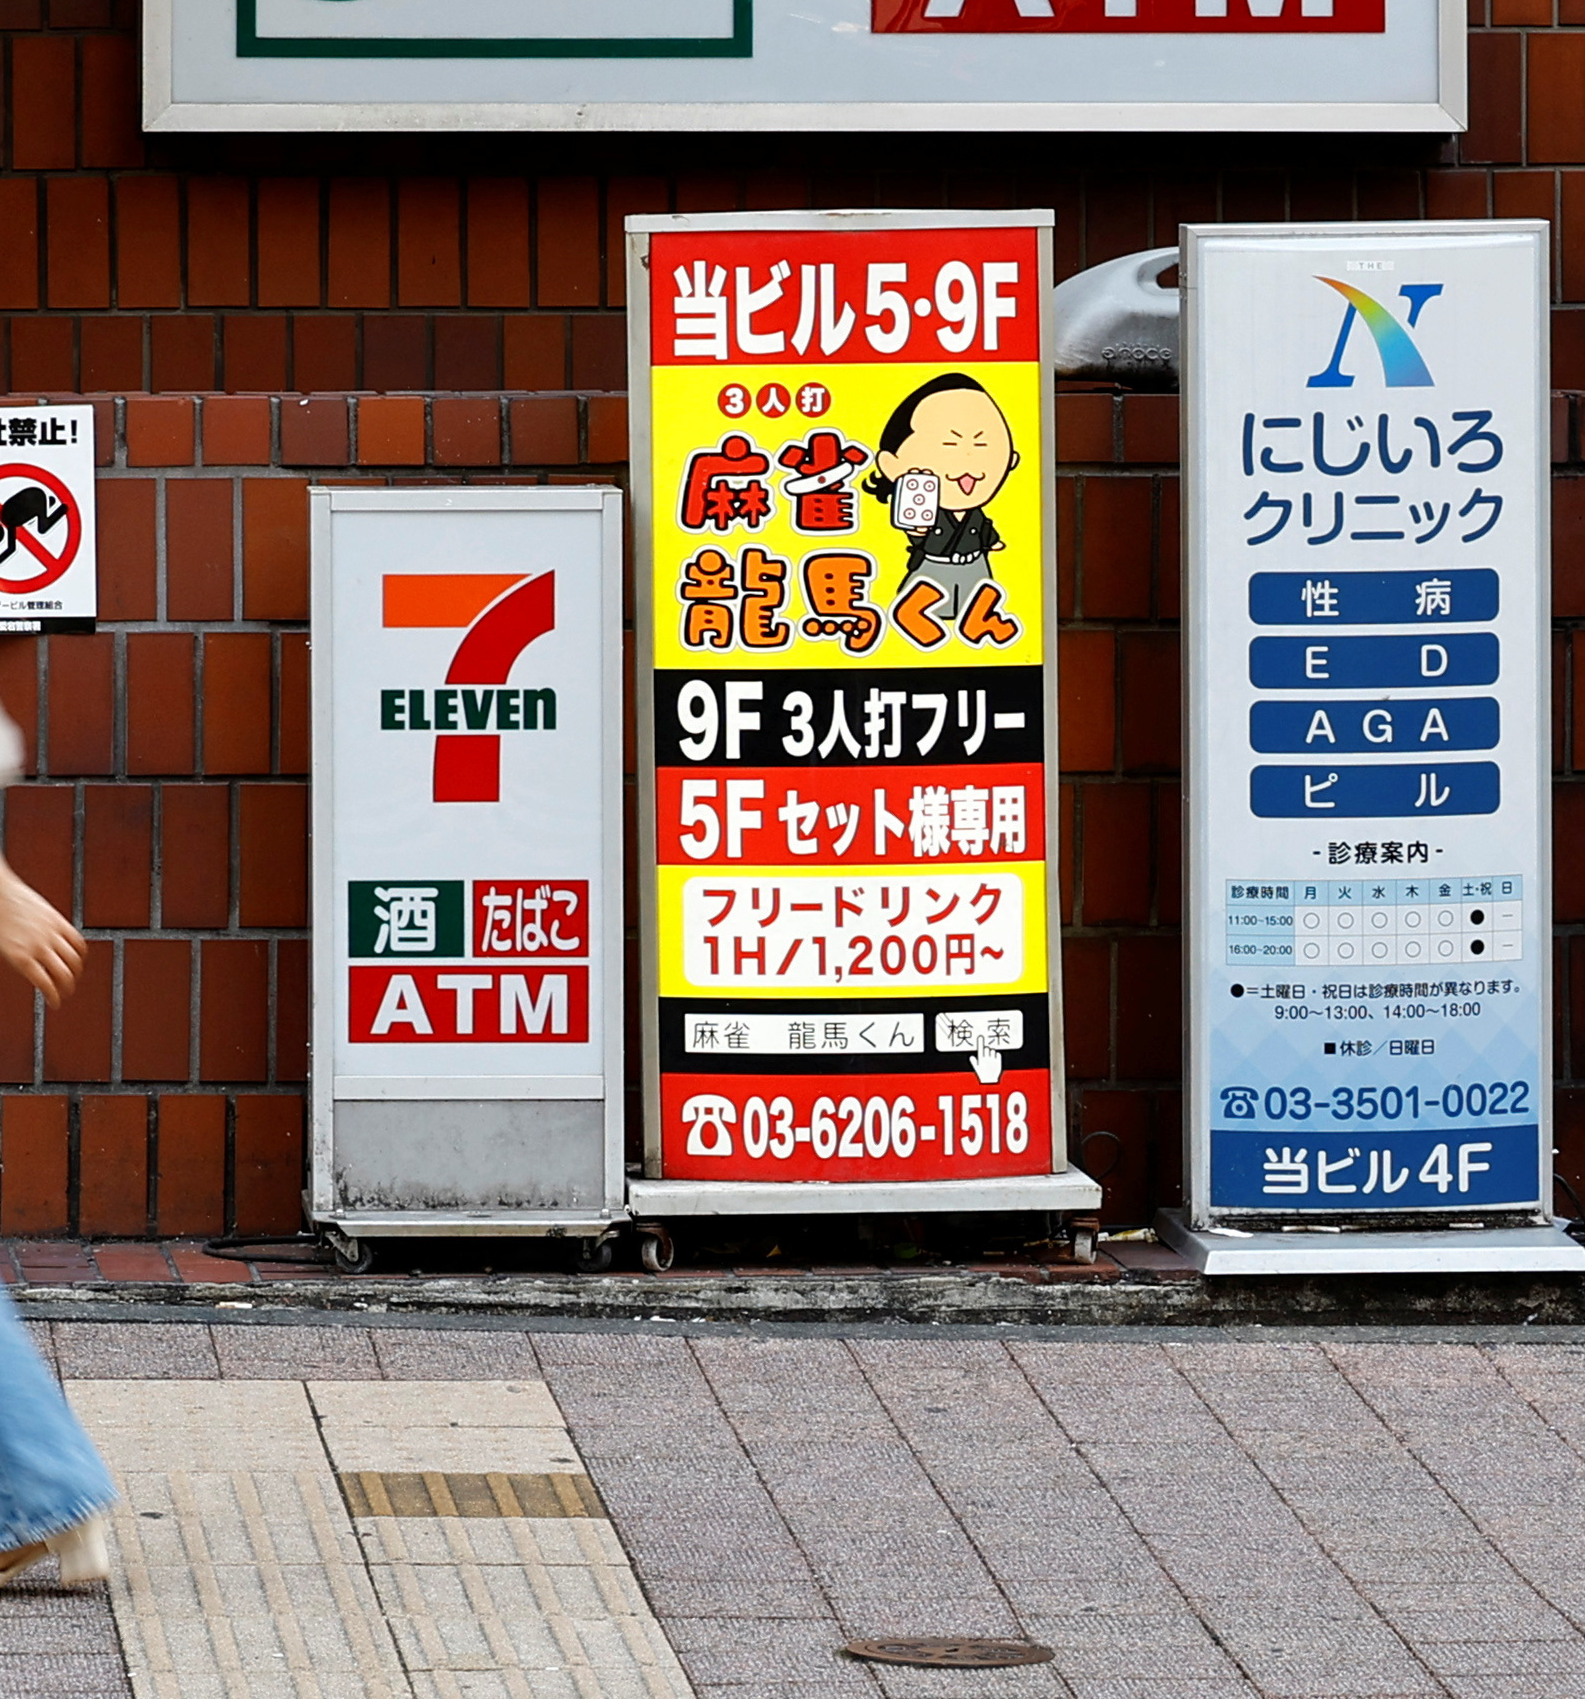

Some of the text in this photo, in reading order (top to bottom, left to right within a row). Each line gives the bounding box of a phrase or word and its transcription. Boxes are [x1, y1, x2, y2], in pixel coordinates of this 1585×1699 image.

[1359, 261, 1383, 270] THE
[1242, 409, 1504, 477] にじいろ
[679, 430, 871, 532] 麻雀
[1243, 487, 1503, 547] クリニック
[679, 546, 1022, 652] 龍馬くん
[677, 679, 1026, 762] 9F 3人打フリー
[678, 779, 1027, 860] 5F セット様専用
[373, 883, 581, 954] 酒 たばこ
[702, 883, 1003, 929] フリードリンク
[1230, 885, 1289, 900] 診療時間
[1304, 886, 1317, 900] 月
[1338, 886, 1352, 899] 火
[1371, 885, 1386, 899] 水
[1405, 884, 1420, 898] 木
[1438, 883, 1452, 897] 金
[1501, 880, 1512, 895] 日
[369, 973, 569, 1036] ATM
[692, 1017, 1011, 1050] 麻雀 龍馬くん 検索
[742, 1091, 1029, 1160] 03-6206-1518
[1264, 1080, 1530, 1120] 03-3501-0022
[1262, 1141, 1493, 1195] 当ビル4F
